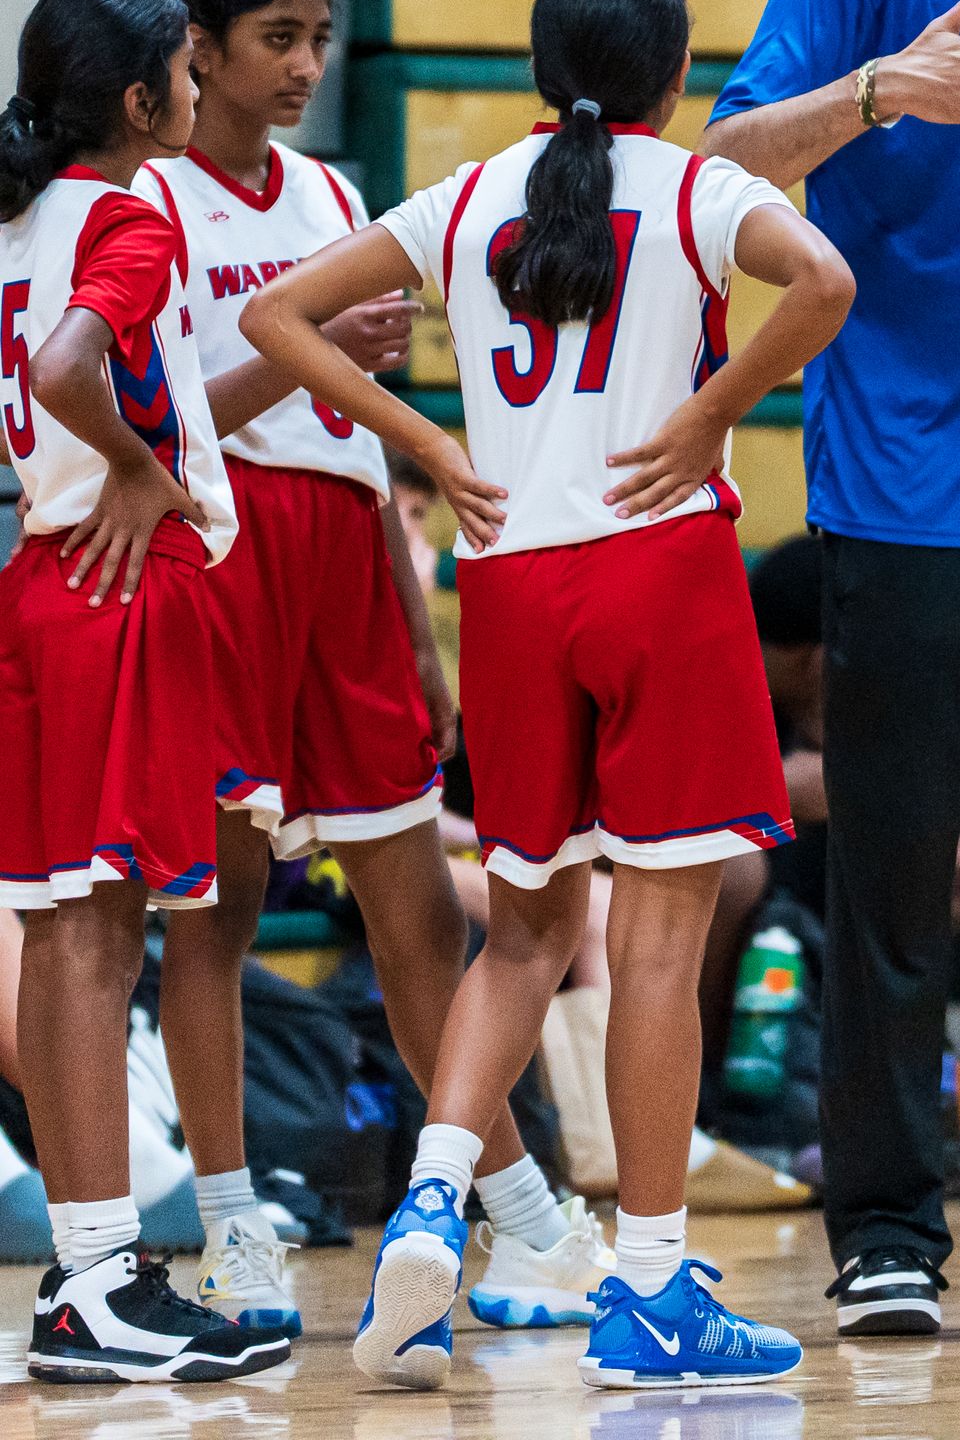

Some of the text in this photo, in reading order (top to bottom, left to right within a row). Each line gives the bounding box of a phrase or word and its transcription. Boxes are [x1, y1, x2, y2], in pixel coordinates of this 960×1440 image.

[1, 278, 37, 460] 5
[206, 258, 305, 300] WAR
[485, 208, 642, 408] 37
